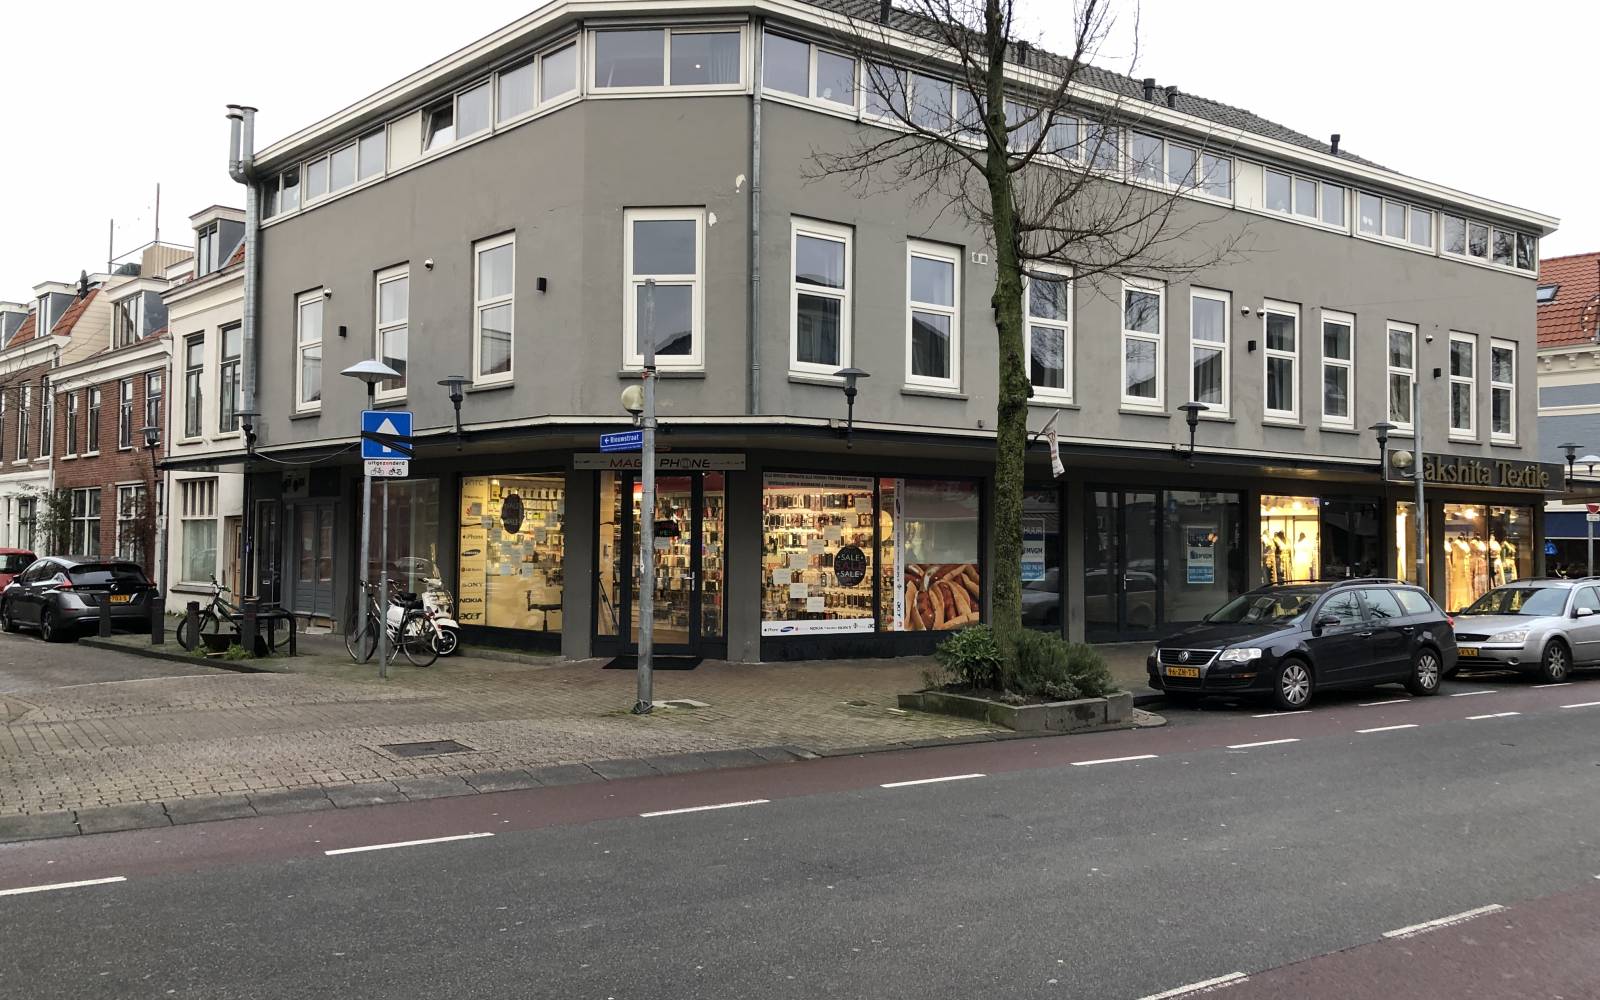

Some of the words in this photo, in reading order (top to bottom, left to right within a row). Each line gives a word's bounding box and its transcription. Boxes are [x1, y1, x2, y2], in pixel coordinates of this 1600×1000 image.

[659, 458, 711, 468] PHONE
[1495, 461, 1550, 488] Textile
[459, 612, 483, 620] acer
